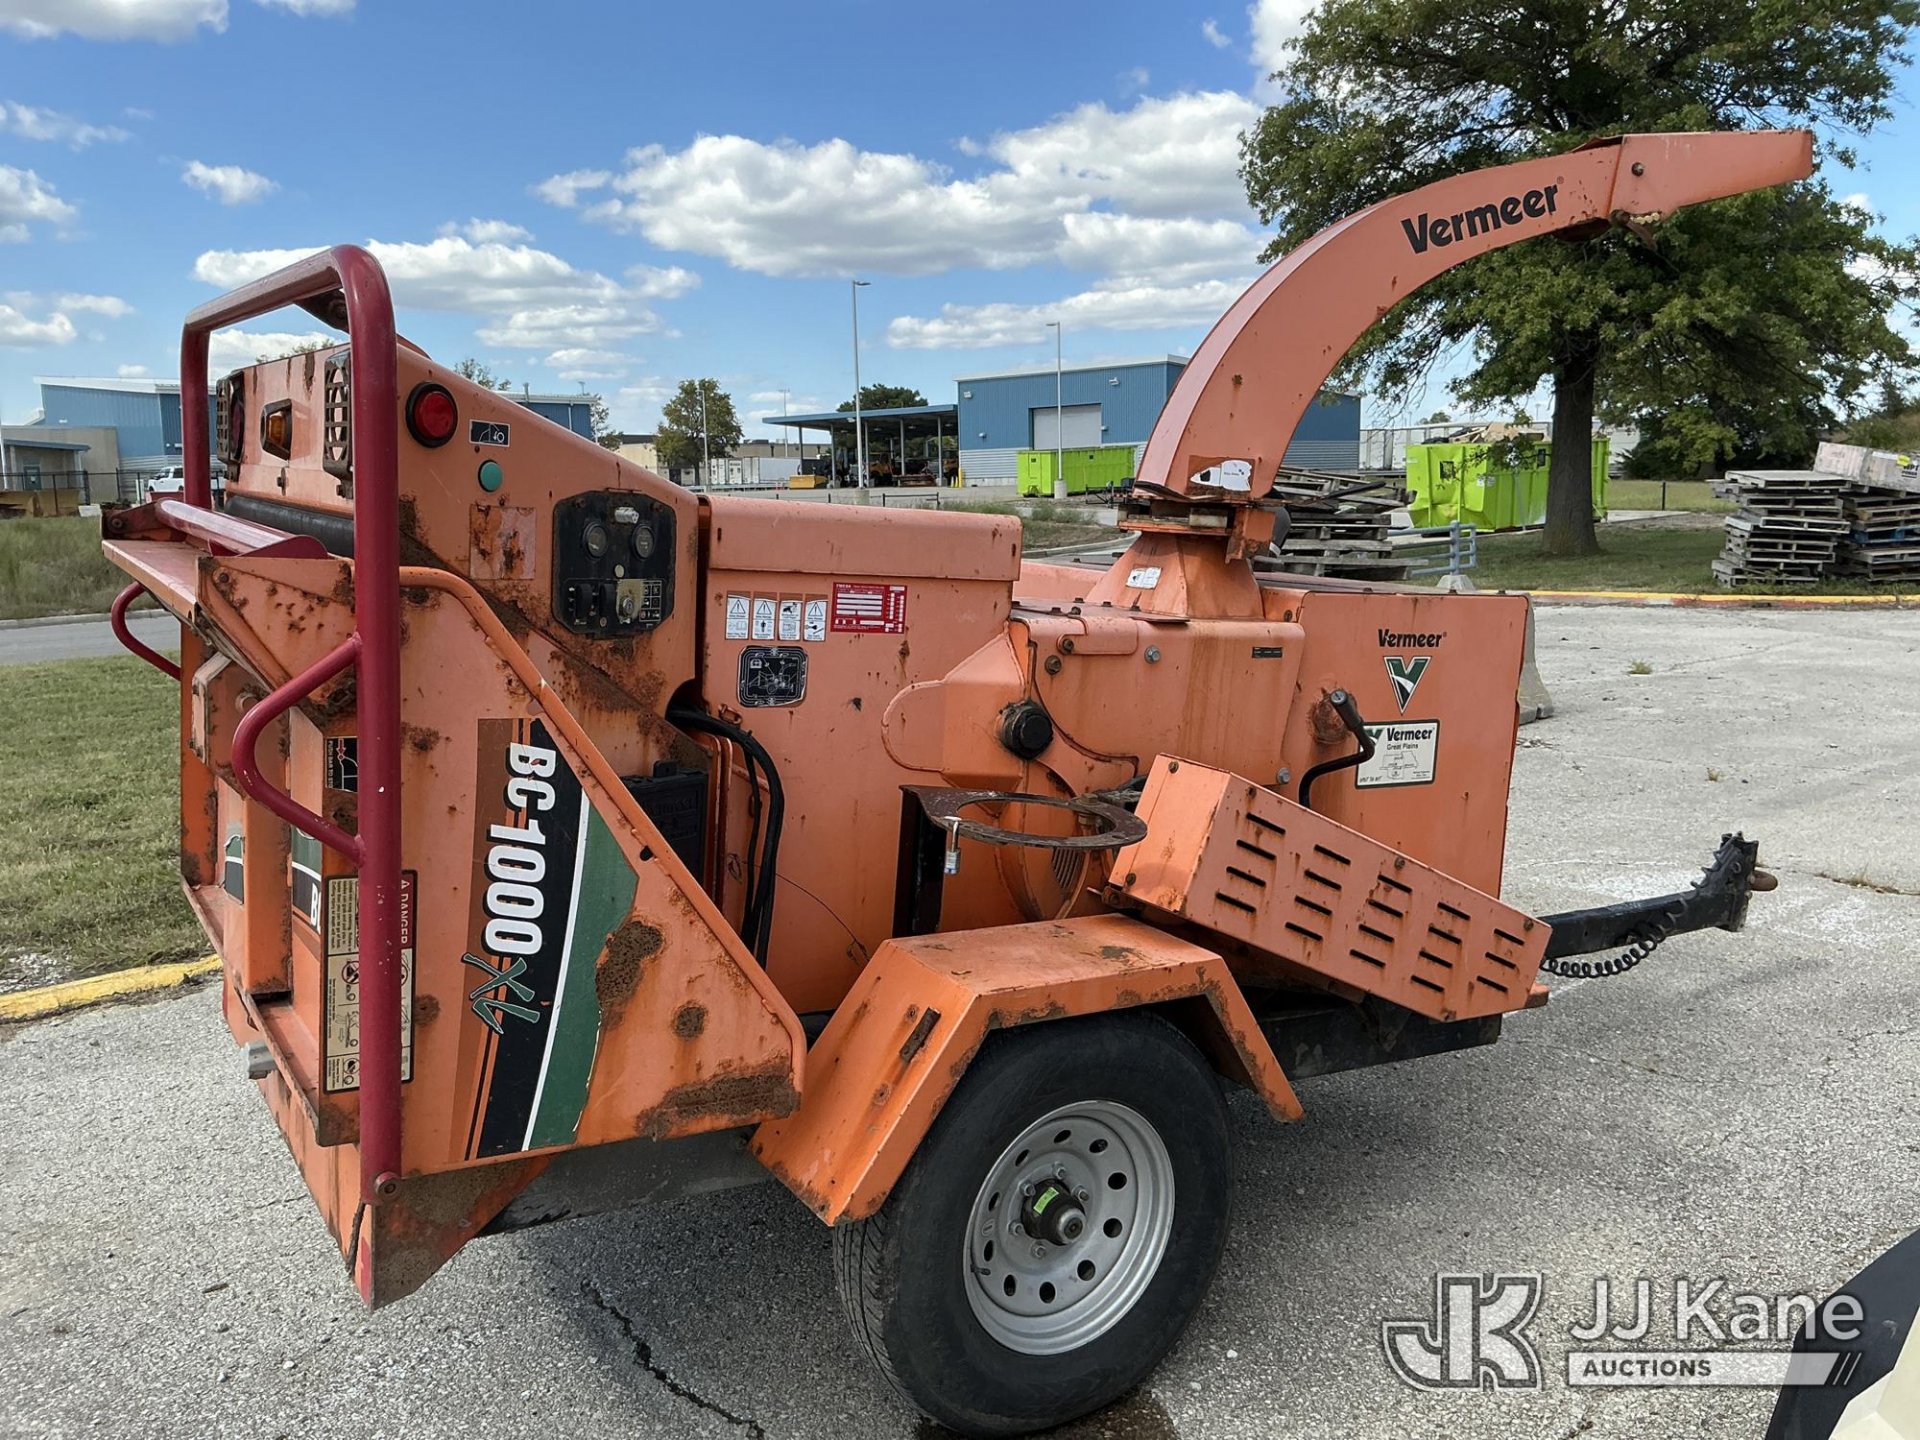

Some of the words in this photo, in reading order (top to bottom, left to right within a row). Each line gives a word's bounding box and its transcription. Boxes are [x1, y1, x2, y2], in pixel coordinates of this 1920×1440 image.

[1401, 184, 1558, 254] Vermeer
[1378, 629, 1443, 648] Vermeer
[1387, 727, 1434, 741] Vermeer
